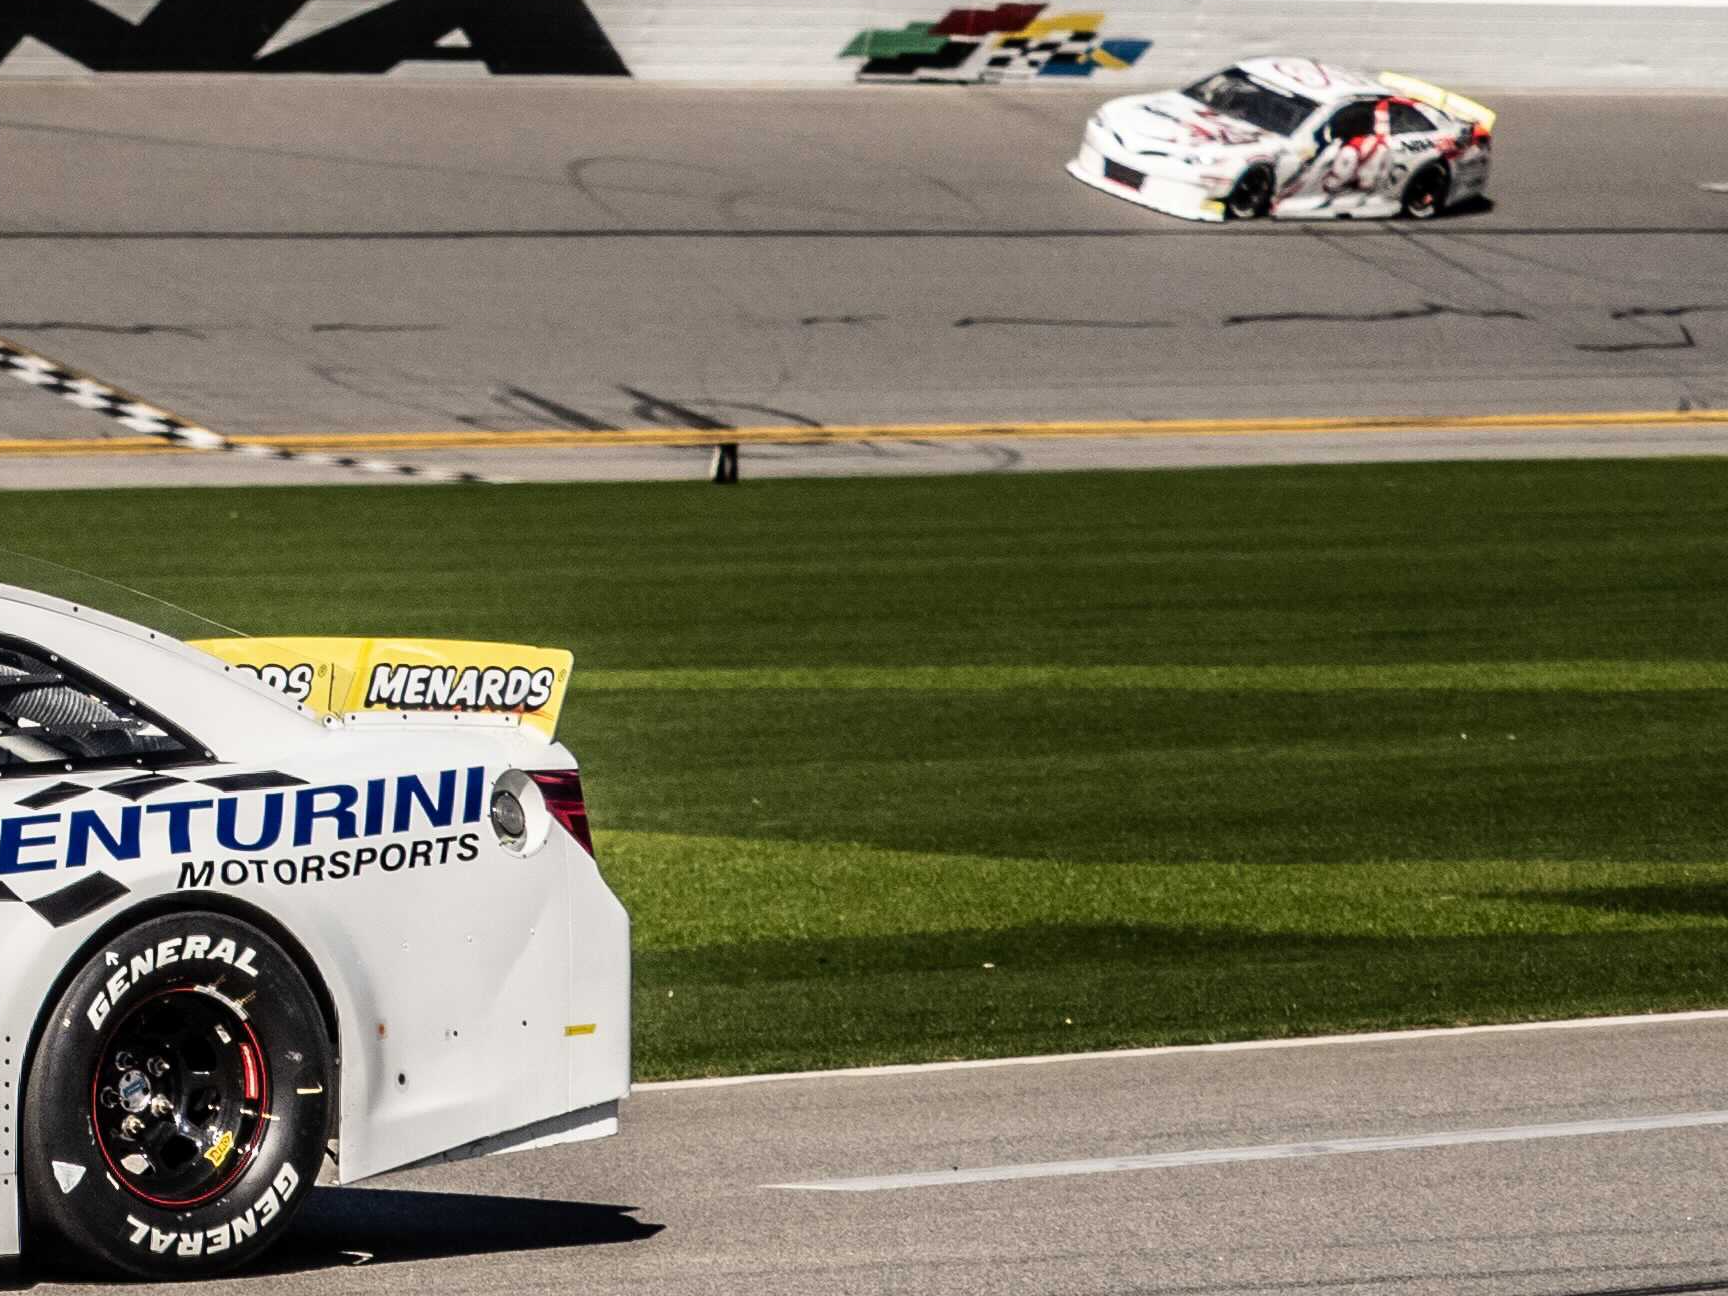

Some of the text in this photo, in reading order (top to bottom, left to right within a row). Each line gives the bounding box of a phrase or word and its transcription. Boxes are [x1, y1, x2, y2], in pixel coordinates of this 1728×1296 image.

[364, 662, 556, 711] MENARDS
[176, 832, 480, 890] MOTORSPORTS
[86, 934, 260, 1032] GENERAL
[126, 1162, 300, 1256] GENERAL
